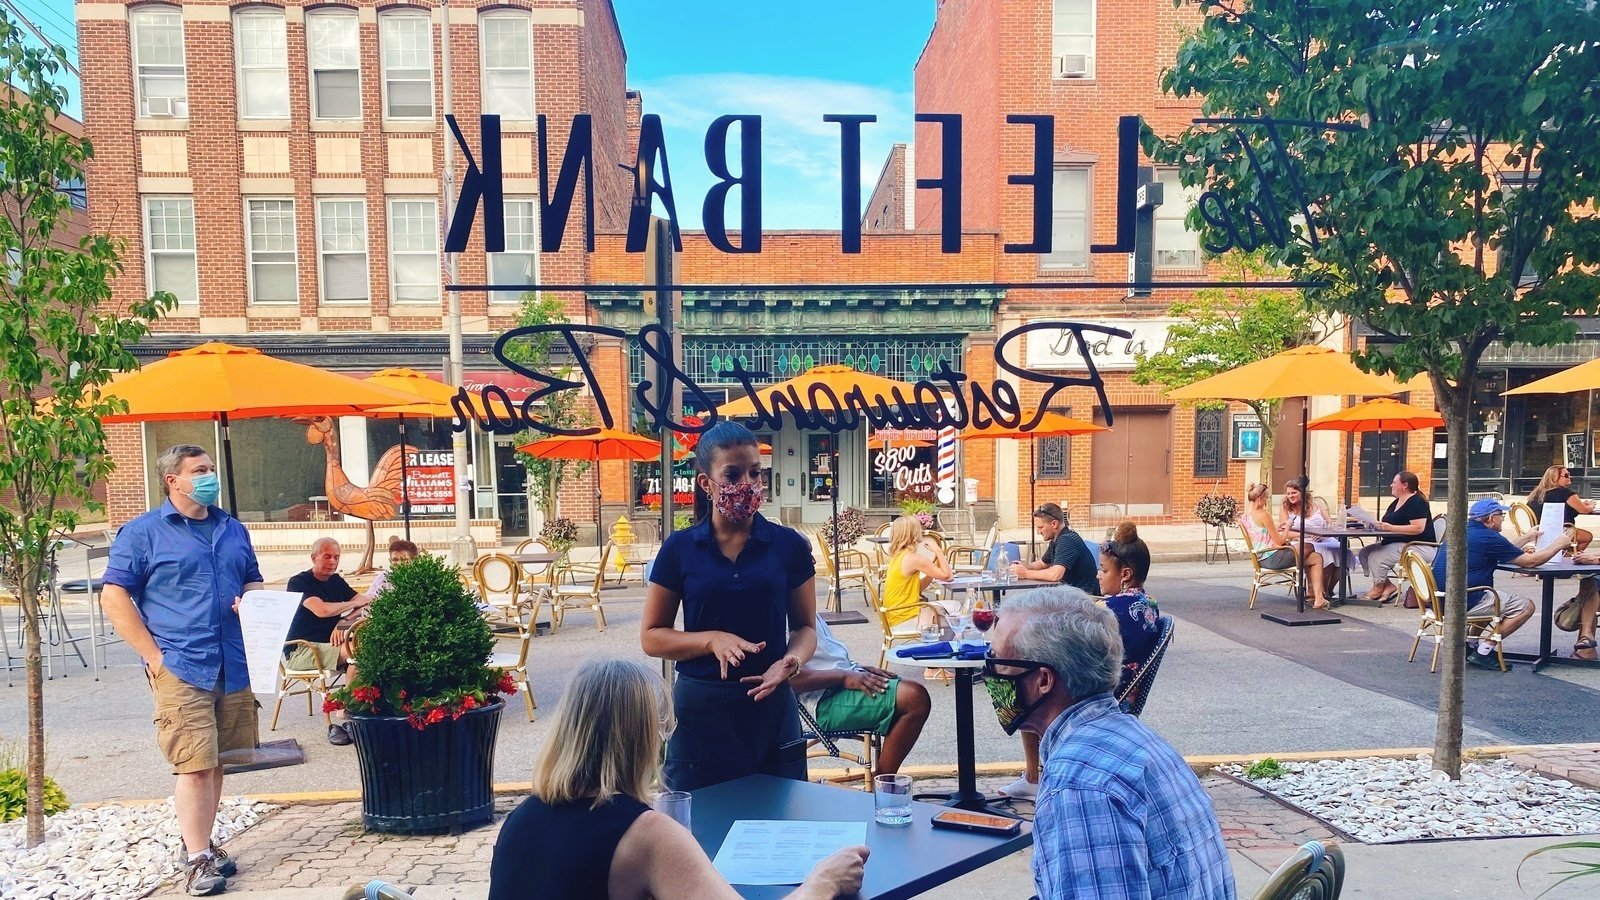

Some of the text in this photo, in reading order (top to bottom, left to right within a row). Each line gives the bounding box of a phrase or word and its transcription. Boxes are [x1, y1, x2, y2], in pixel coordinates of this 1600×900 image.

[420, 453, 454, 466] LEASE
[874, 445, 916, 475] $8.00
[411, 470, 452, 480] Bennett
[896, 463, 932, 491] Cuts
[400, 490, 454, 498] 77-843-5555
[921, 485, 932, 493] UP
